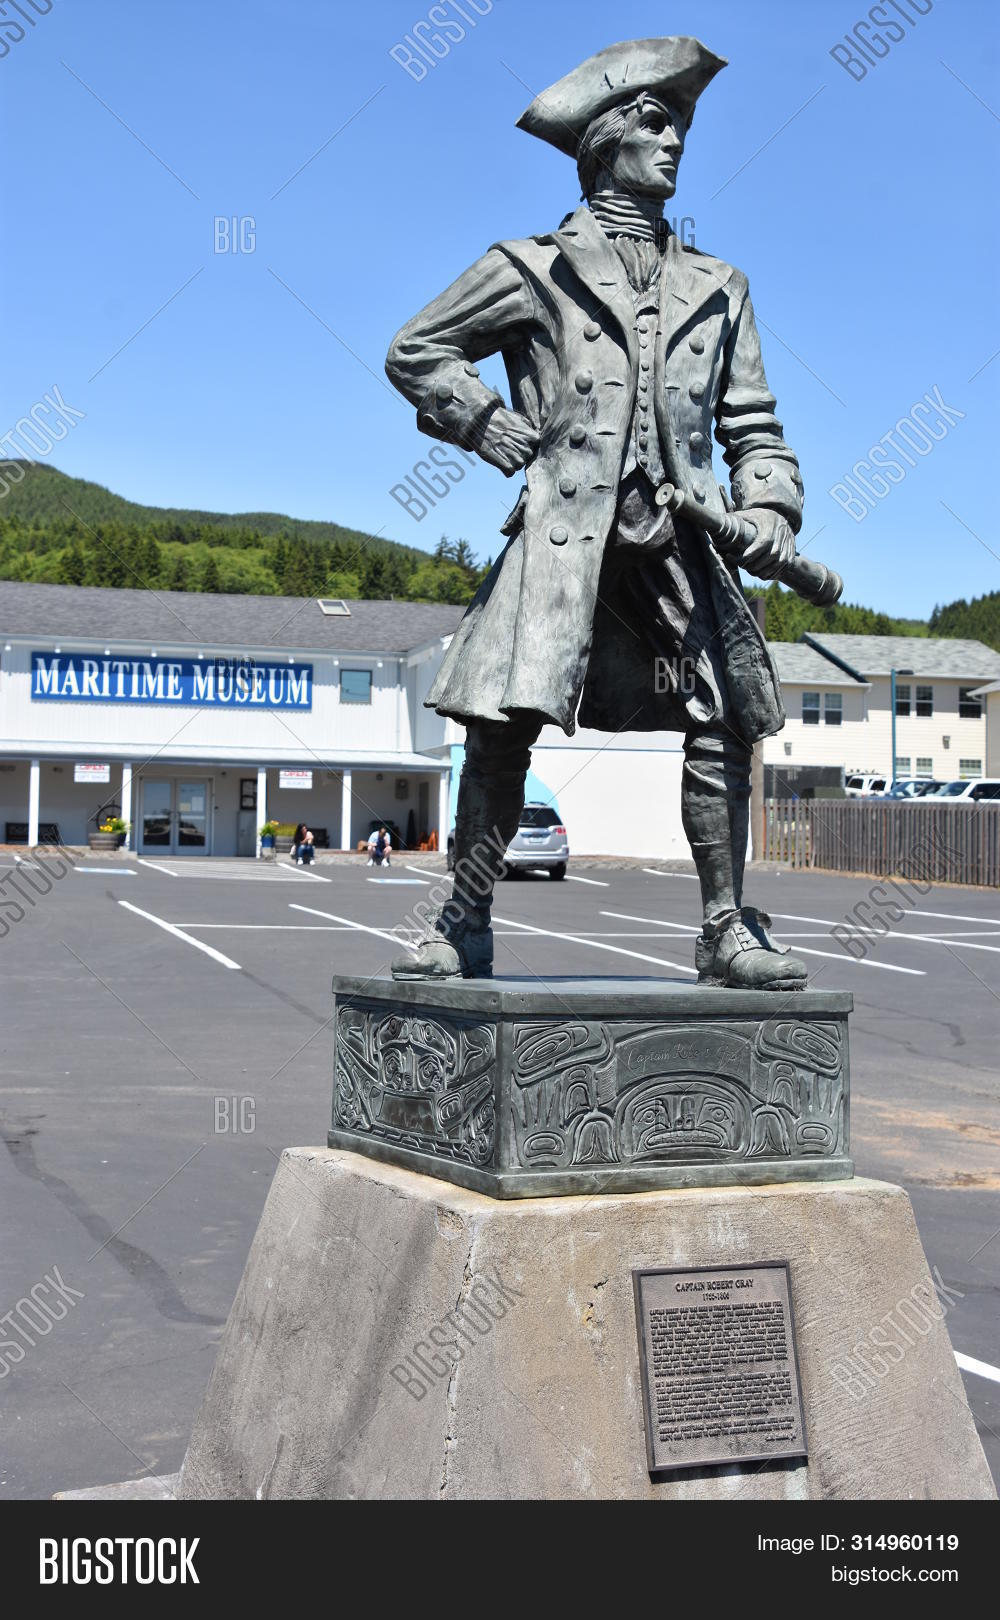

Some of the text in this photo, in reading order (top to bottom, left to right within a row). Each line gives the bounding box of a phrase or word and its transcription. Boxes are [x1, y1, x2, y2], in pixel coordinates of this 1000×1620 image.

[35, 657, 310, 705] MARITIME MUSEUM
[675, 1278, 755, 1293] CAPTAIN ROBERT GRAY
